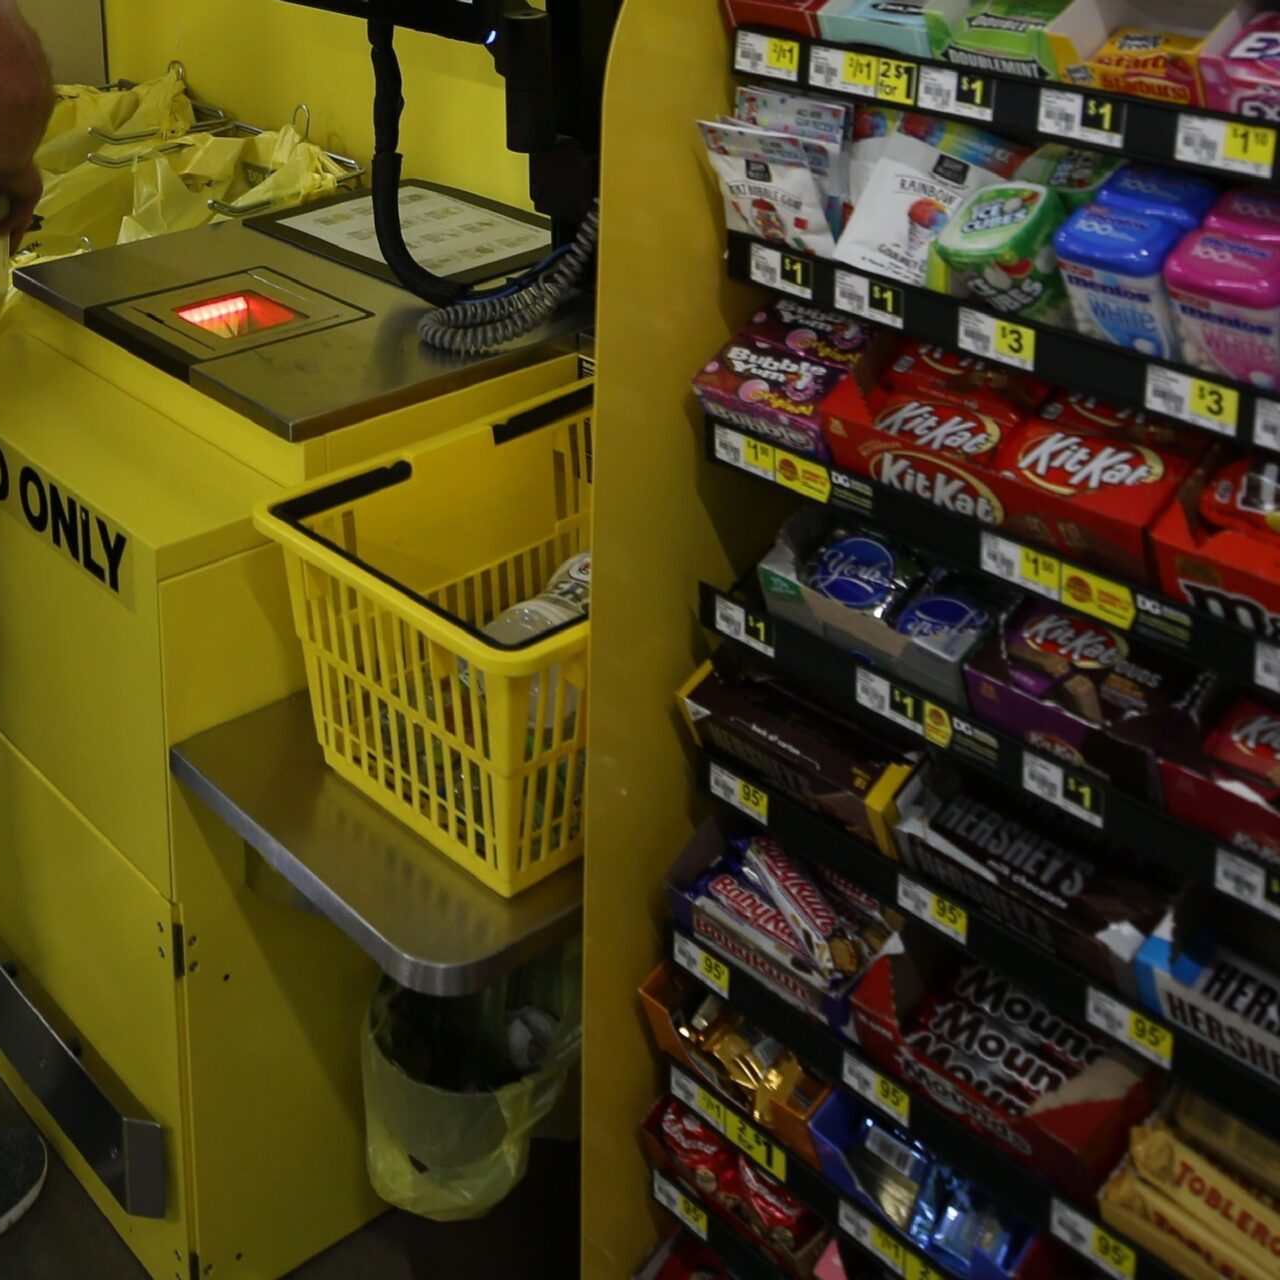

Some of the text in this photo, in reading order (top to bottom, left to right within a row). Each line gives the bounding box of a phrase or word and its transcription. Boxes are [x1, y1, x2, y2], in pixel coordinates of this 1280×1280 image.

[880, 61, 893, 79] 2
[948, 49, 1041, 78] DOUBLEMINT
[879, 81, 899, 97] for
[961, 76, 985, 105] $1
[1088, 100, 1113, 131] $1
[899, 177, 958, 206] RAINBOW
[784, 257, 802, 285] $1
[872, 284, 893, 313] $1
[1069, 272, 1151, 304] mentos
[1181, 303, 1272, 336] mentos
[1001, 325, 1024, 355] $3
[727, 346, 828, 377] Bubble
[730, 359, 786, 383] Yum
[1198, 384, 1225, 417] $3
[830, 469, 851, 488] DG
[20, 464, 128, 593] ONLY
[1136, 594, 1162, 615] DG
[748, 615, 766, 643] $1
[894, 688, 915, 719] $1
[1067, 777, 1093, 810] $1
